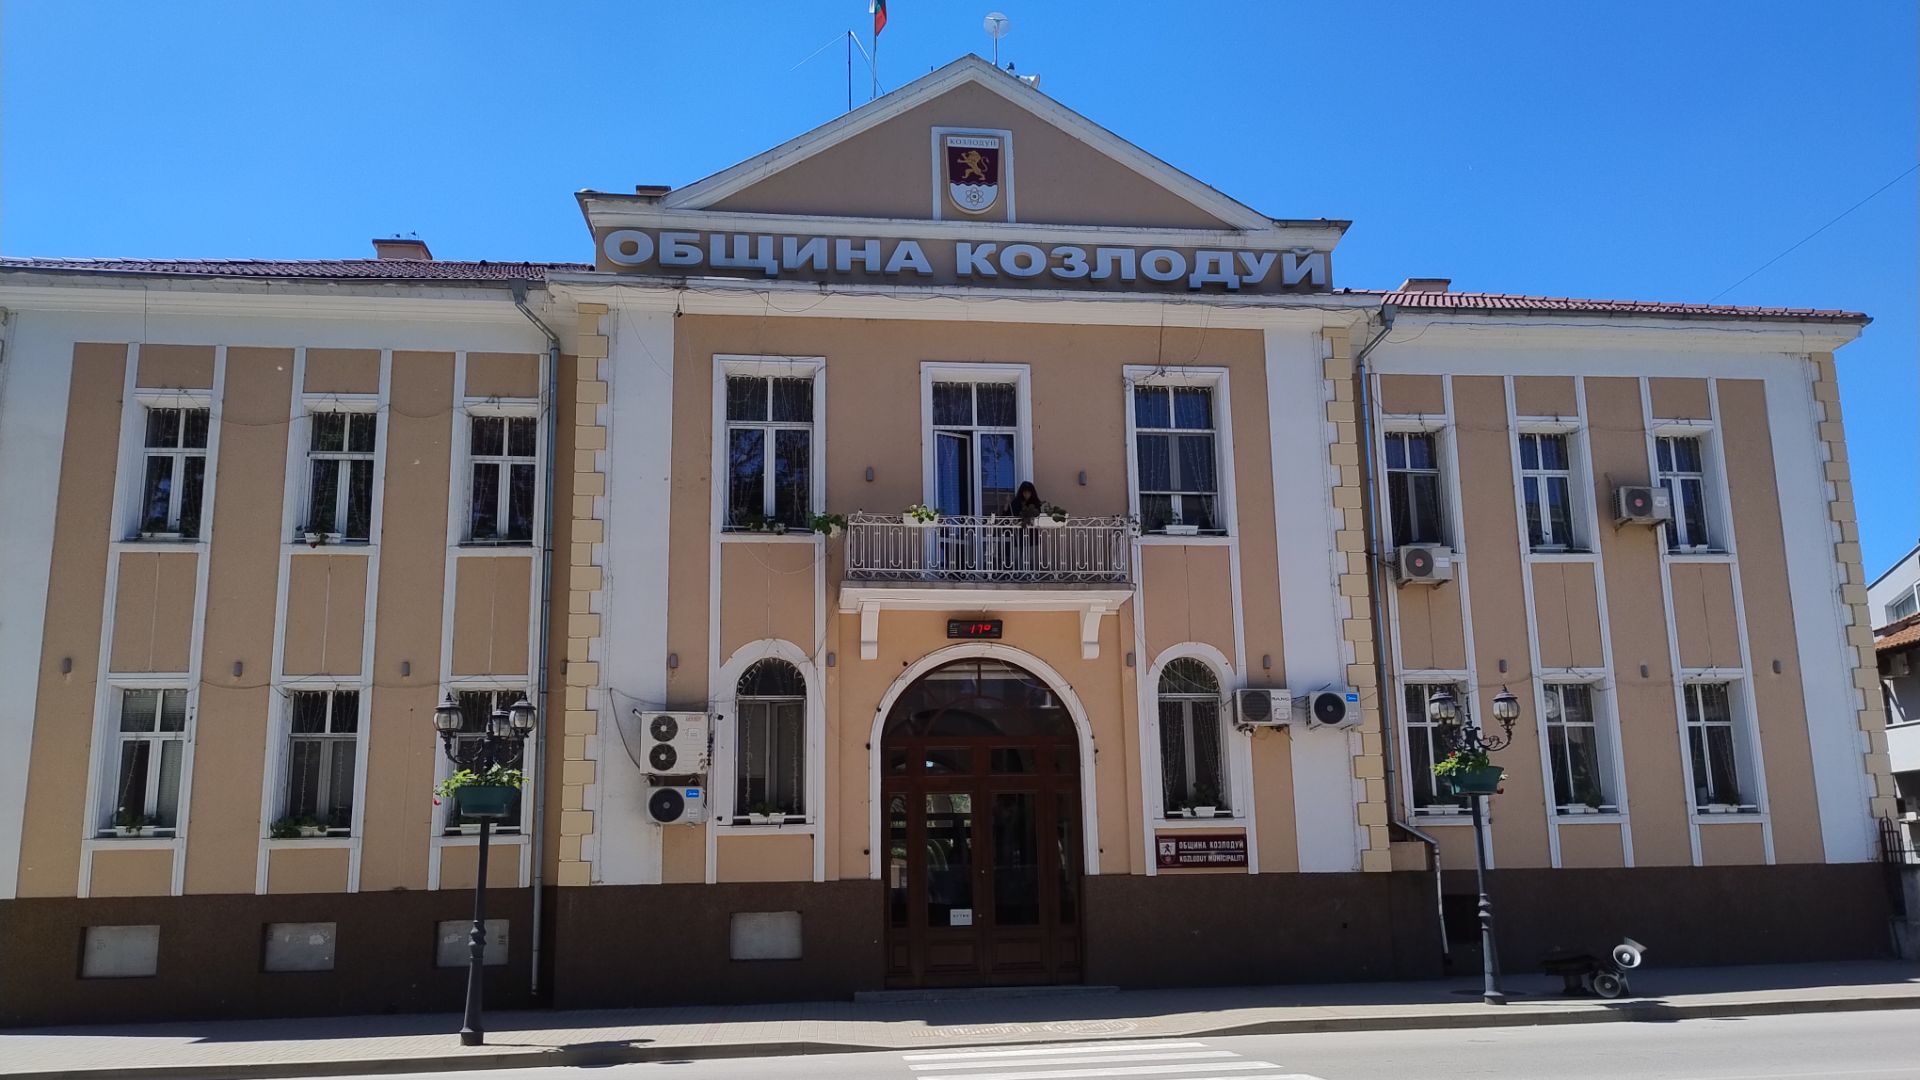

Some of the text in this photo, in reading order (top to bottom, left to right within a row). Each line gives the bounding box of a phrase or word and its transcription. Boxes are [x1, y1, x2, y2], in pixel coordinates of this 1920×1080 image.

[603, 229, 1327, 291] ОБЩИНА КОЗЛОДУЙ
[1178, 841, 1207, 850] ОБЩИНА
[1209, 840, 1244, 849] КОЗЛОДУЙ
[1179, 854, 1245, 863] KOZLODUY MUNICIPALITY
